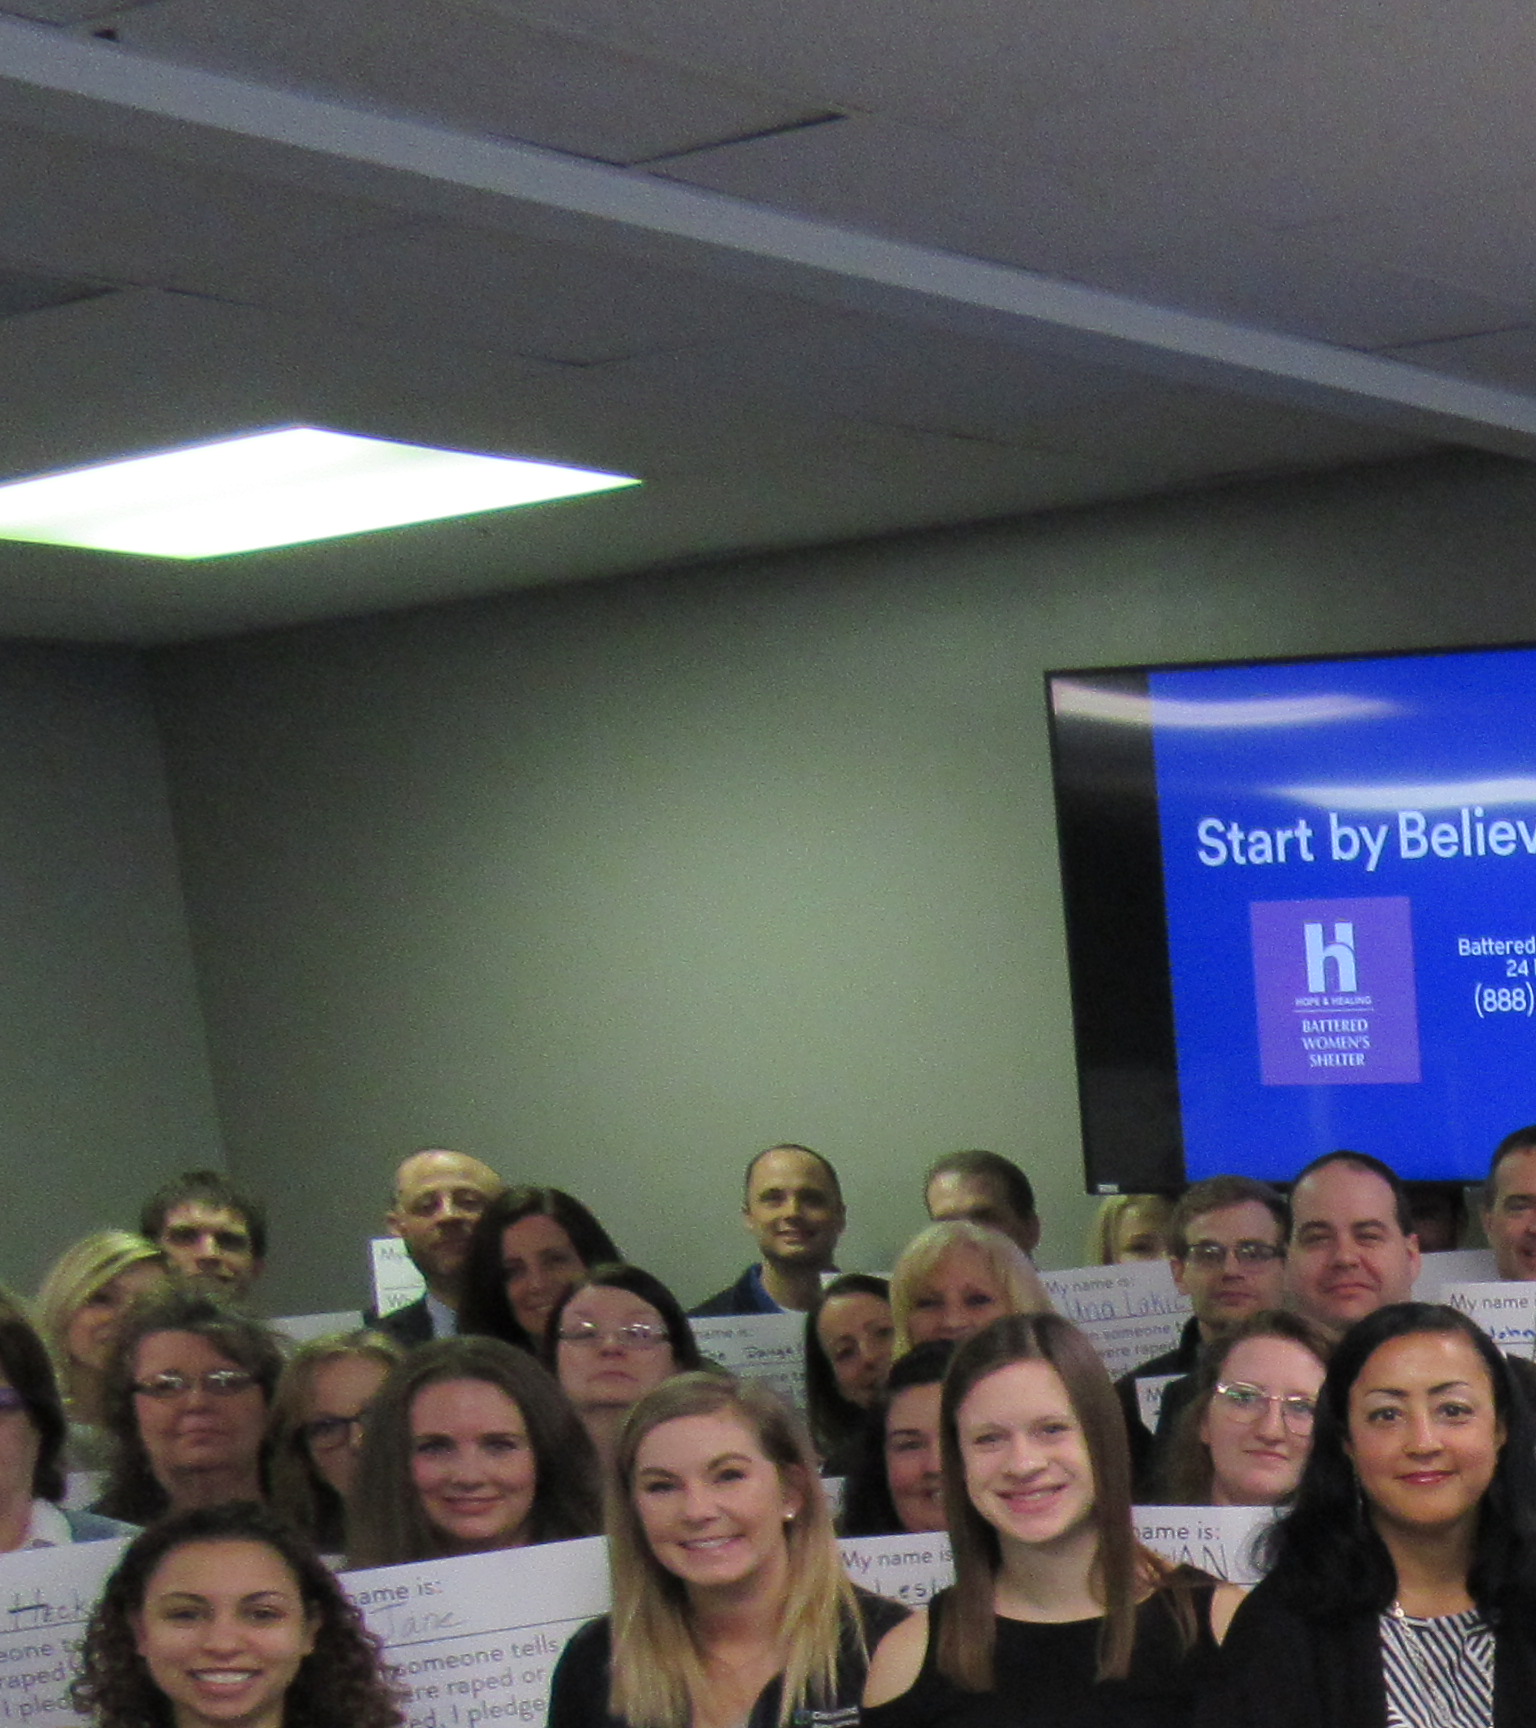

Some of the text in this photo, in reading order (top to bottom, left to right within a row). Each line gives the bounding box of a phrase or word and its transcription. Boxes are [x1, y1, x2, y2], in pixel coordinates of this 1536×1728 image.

[1197, 817, 1314, 867] Start
[1329, 812, 1389, 872] by
[1458, 936, 1536, 956] Battered
[1506, 959, 1529, 977] 24
[1475, 981, 1535, 1019] (888)
[1302, 1019, 1369, 1033] BATTERED
[1303, 1036, 1371, 1051] WOMEN'S
[1309, 1053, 1366, 1068] SHELTER
[512, 1634, 559, 1659] tells
